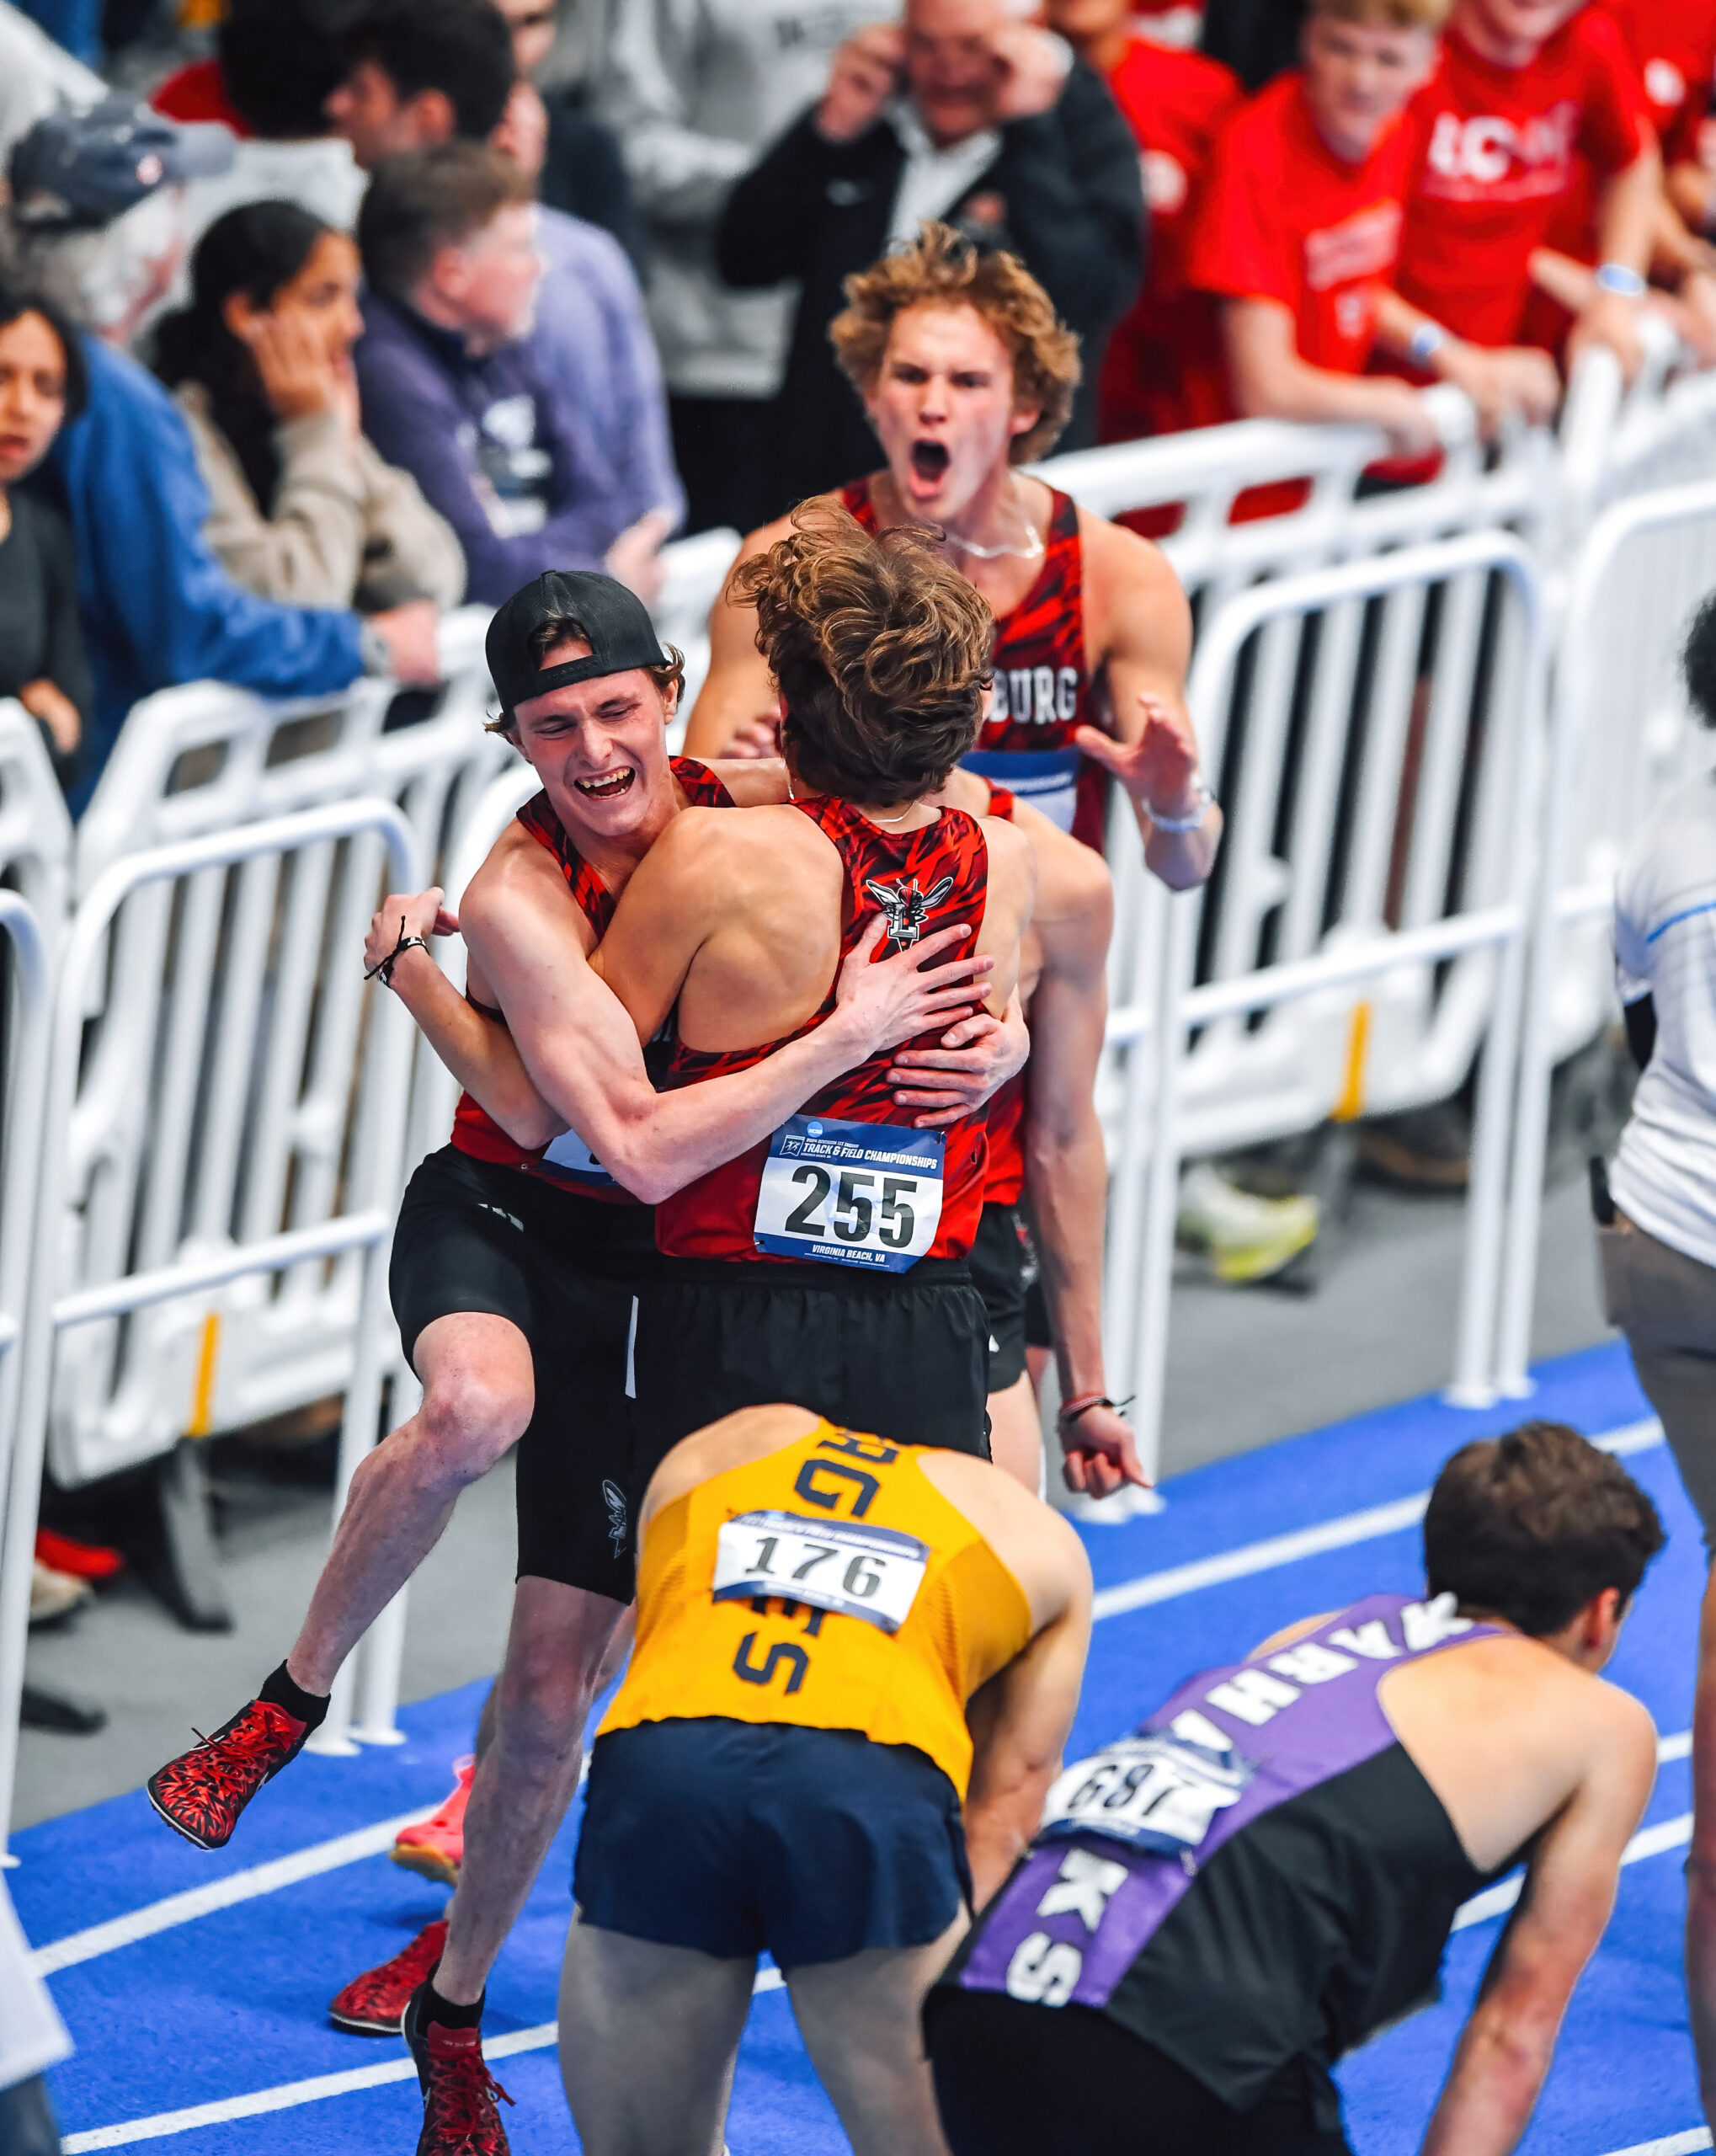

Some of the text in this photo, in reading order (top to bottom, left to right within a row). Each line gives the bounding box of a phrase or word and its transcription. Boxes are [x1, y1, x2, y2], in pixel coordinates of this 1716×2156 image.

[802, 1142, 834, 1154] TRACK
[833, 1146, 841, 1155] &
[840, 1147, 865, 1159] FIELD
[864, 1149, 938, 1170] CHAMPIONSHIPS
[784, 1165, 918, 1248] 255
[812, 1245, 845, 1257] VIRGINIA
[846, 1250, 873, 1262] BEACH,
[875, 1253, 886, 1262] VA
[744, 1536, 887, 1597] 176
